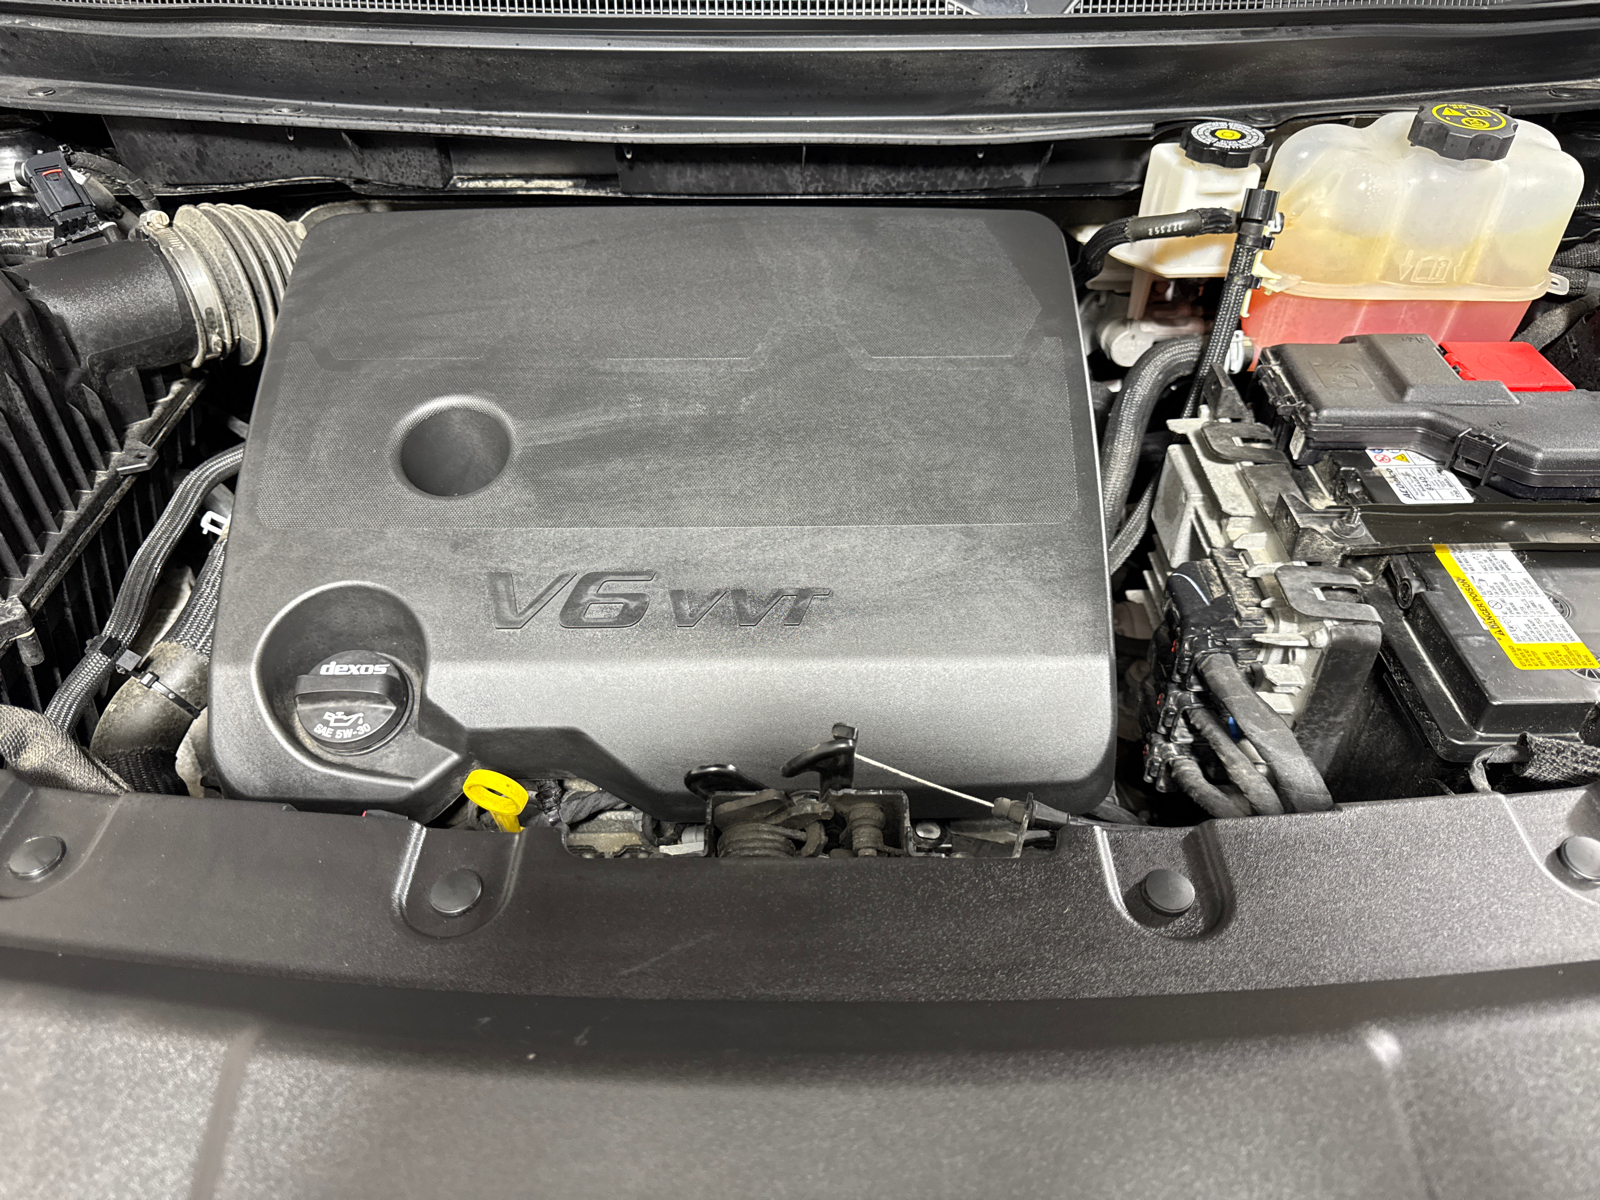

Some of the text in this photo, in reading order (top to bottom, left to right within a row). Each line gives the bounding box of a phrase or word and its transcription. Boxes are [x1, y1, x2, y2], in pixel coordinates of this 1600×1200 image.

[488, 571, 832, 629] V6 VVT
[320, 661, 391, 675] dexos
[313, 723, 371, 738] SAE 5W-30
